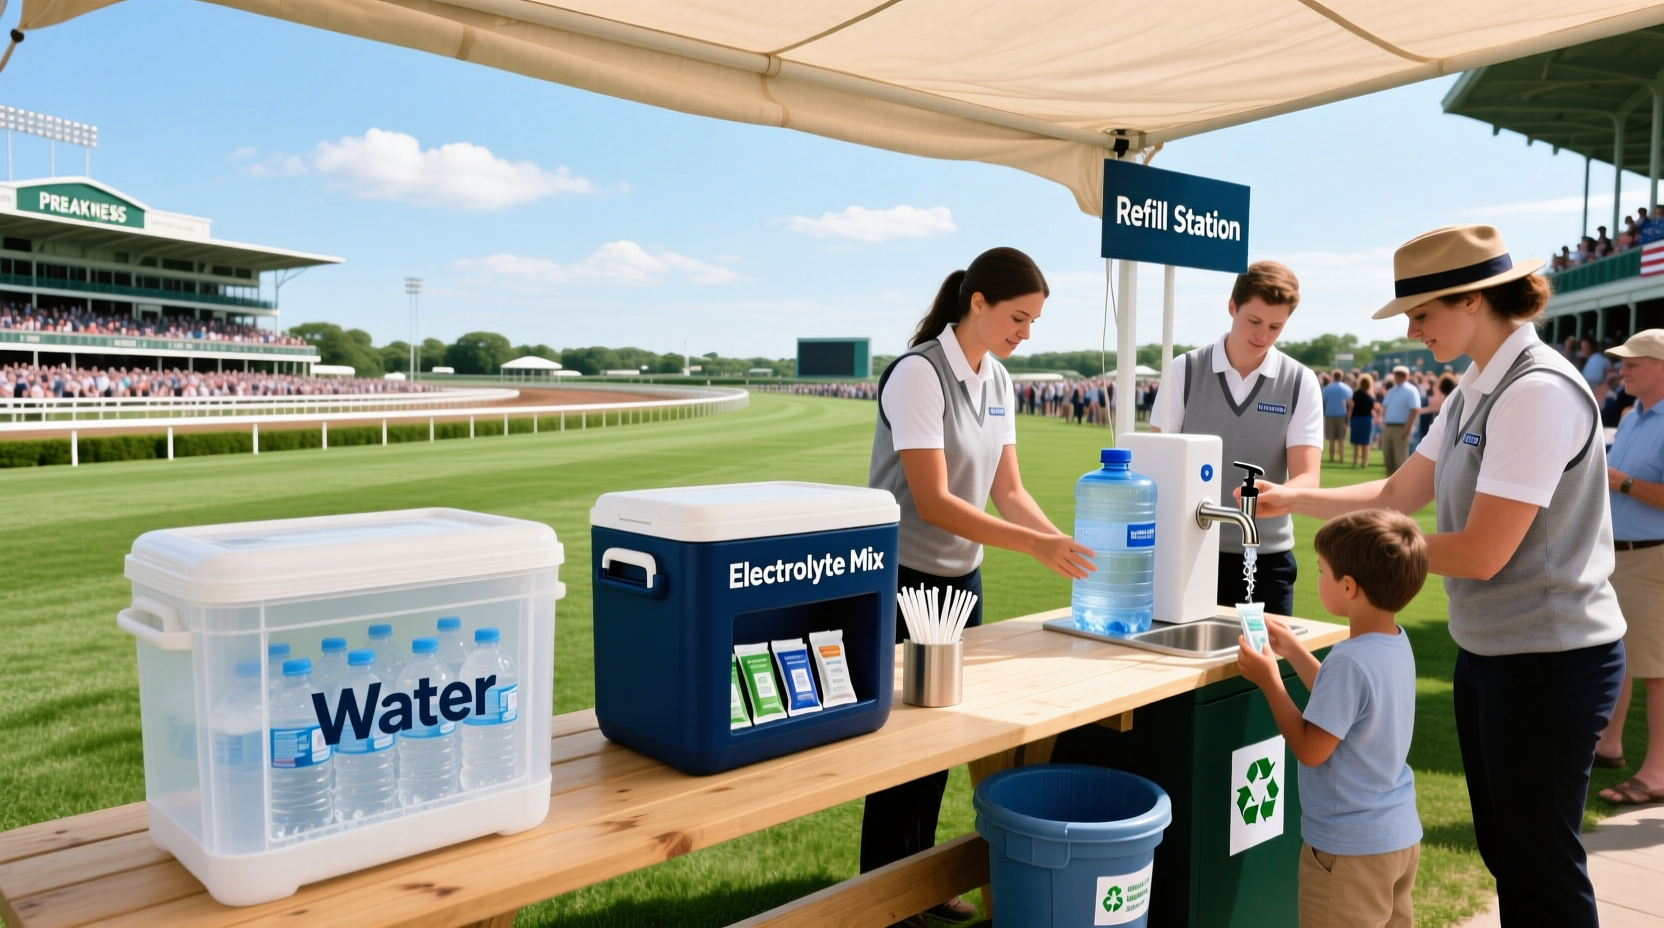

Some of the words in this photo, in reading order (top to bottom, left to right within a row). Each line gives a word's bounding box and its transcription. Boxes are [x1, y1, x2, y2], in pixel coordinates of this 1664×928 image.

[39, 191, 127, 223] PREAKNESS
[1116, 195, 1168, 231] Refill
[1173, 205, 1241, 241] Station
[729, 553, 846, 590] Electrolyte
[850, 546, 884, 573] Mix
[311, 674, 497, 746] Water
